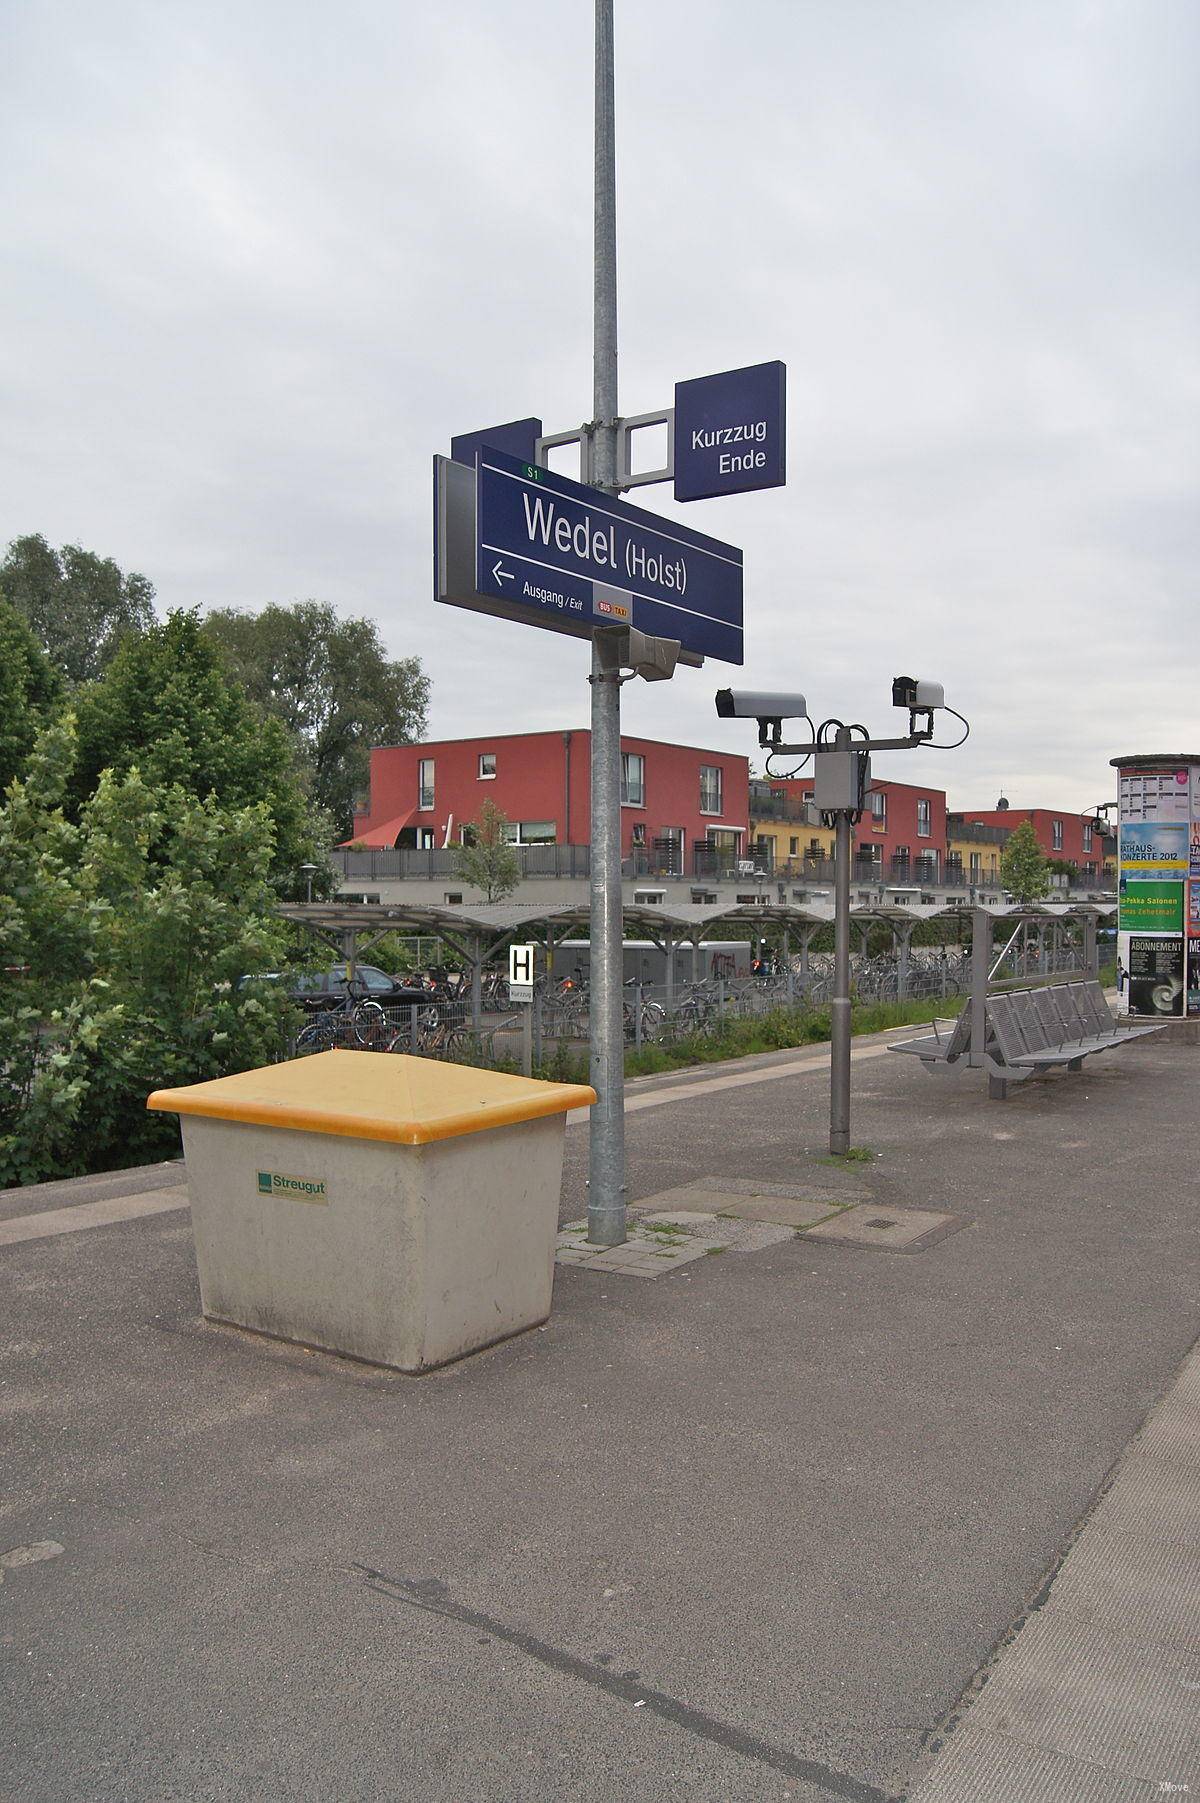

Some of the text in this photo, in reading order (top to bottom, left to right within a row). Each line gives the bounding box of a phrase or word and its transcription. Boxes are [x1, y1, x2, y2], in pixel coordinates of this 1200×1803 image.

[692, 421, 767, 450] Kurzzug
[719, 449, 766, 474] Ende
[522, 492, 687, 596] Wedel (Holst)
[522, 581, 564, 608] Ausgang
[569, 597, 584, 611] Exit
[599, 602, 611, 613] BUS
[614, 606, 627, 617] TAXI
[1159, 852, 1178, 861] 2012
[1146, 897, 1178, 905] Salonen
[1131, 941, 1182, 952] ABONNEMENT
[513, 949, 530, 981] H
[273, 1175, 326, 1195] Streugut
